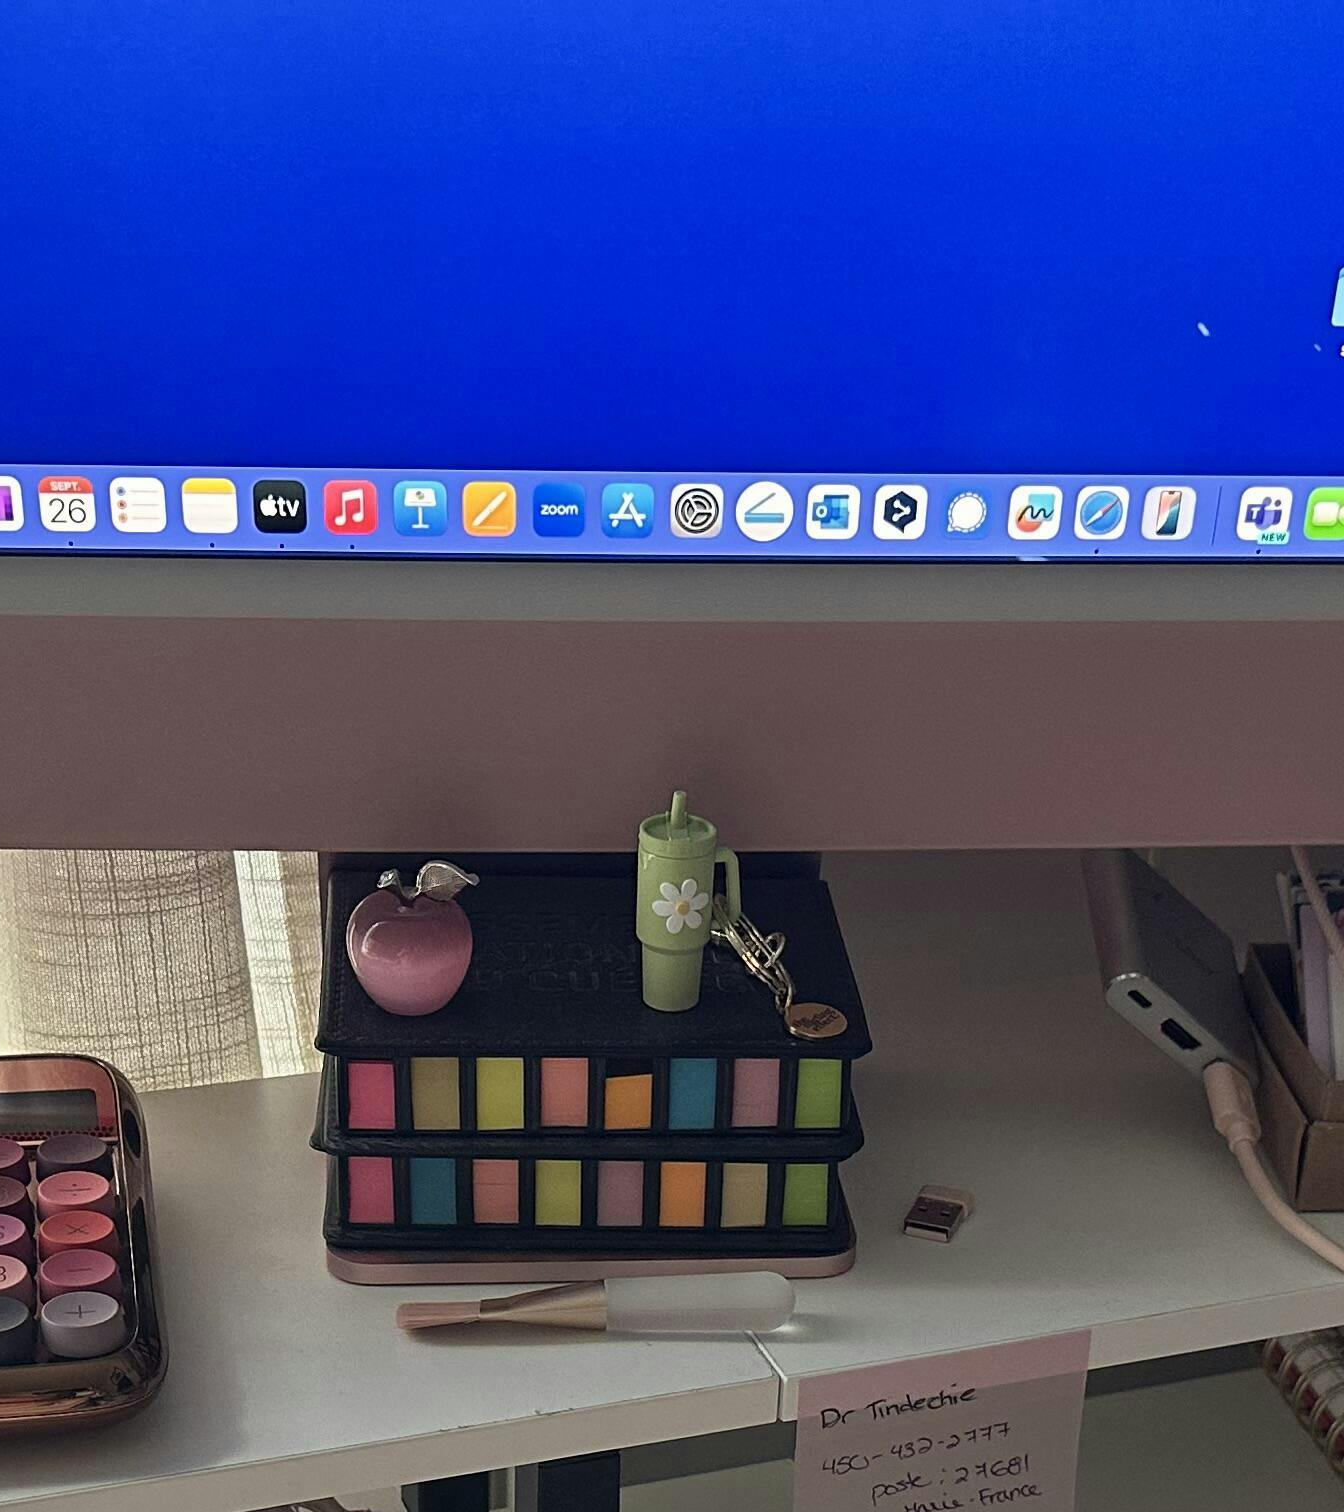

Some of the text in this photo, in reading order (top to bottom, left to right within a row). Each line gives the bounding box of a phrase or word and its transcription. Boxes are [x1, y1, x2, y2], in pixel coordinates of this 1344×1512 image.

[47, 498, 88, 524] 26
[539, 503, 580, 518] zoom
[1261, 533, 1287, 545] NEW
[820, 1407, 857, 1430] Dr
